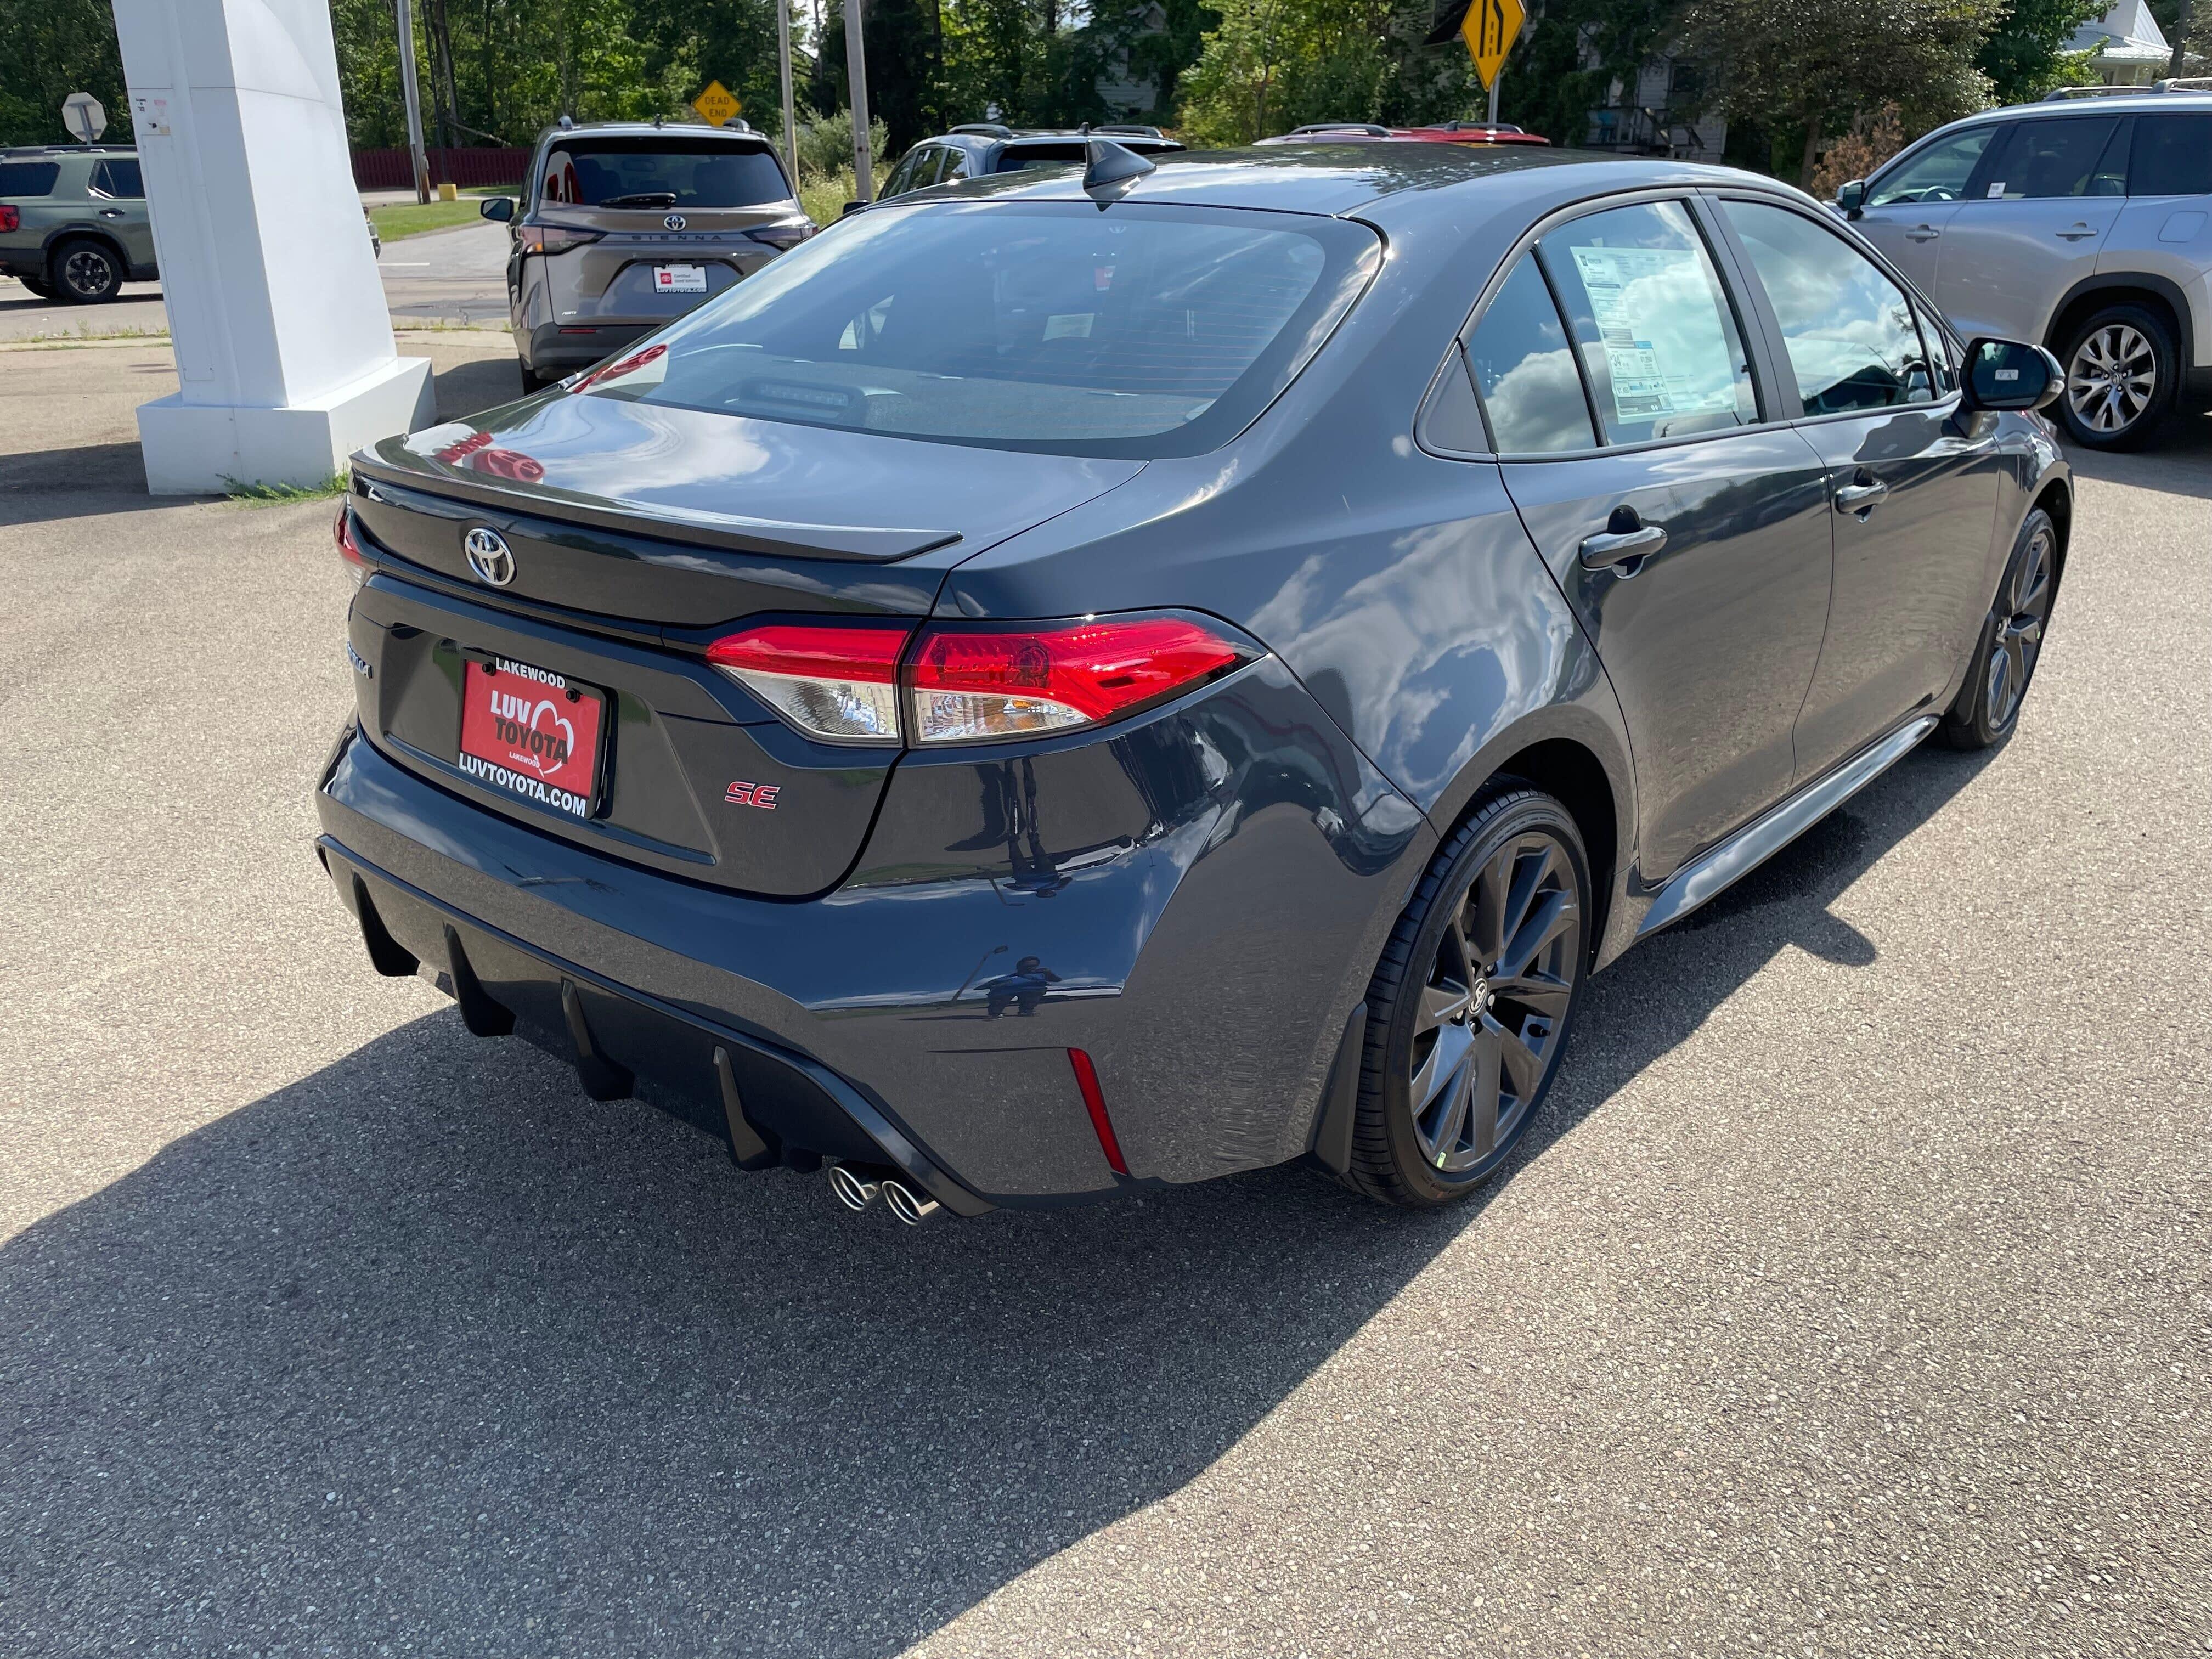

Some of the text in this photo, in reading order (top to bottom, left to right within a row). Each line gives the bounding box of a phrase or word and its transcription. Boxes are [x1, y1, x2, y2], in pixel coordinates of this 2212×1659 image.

[704, 96, 729, 105] DEAD
[709, 109, 727, 117] END
[495, 657, 566, 689] LAKEWOOD
[490, 690, 531, 724] LUV
[495, 717, 568, 765] TOYOTA
[509, 751, 540, 768] LAKEWOOD
[458, 752, 588, 817] LUVTOYOTA.COM
[724, 781, 781, 809] SE
